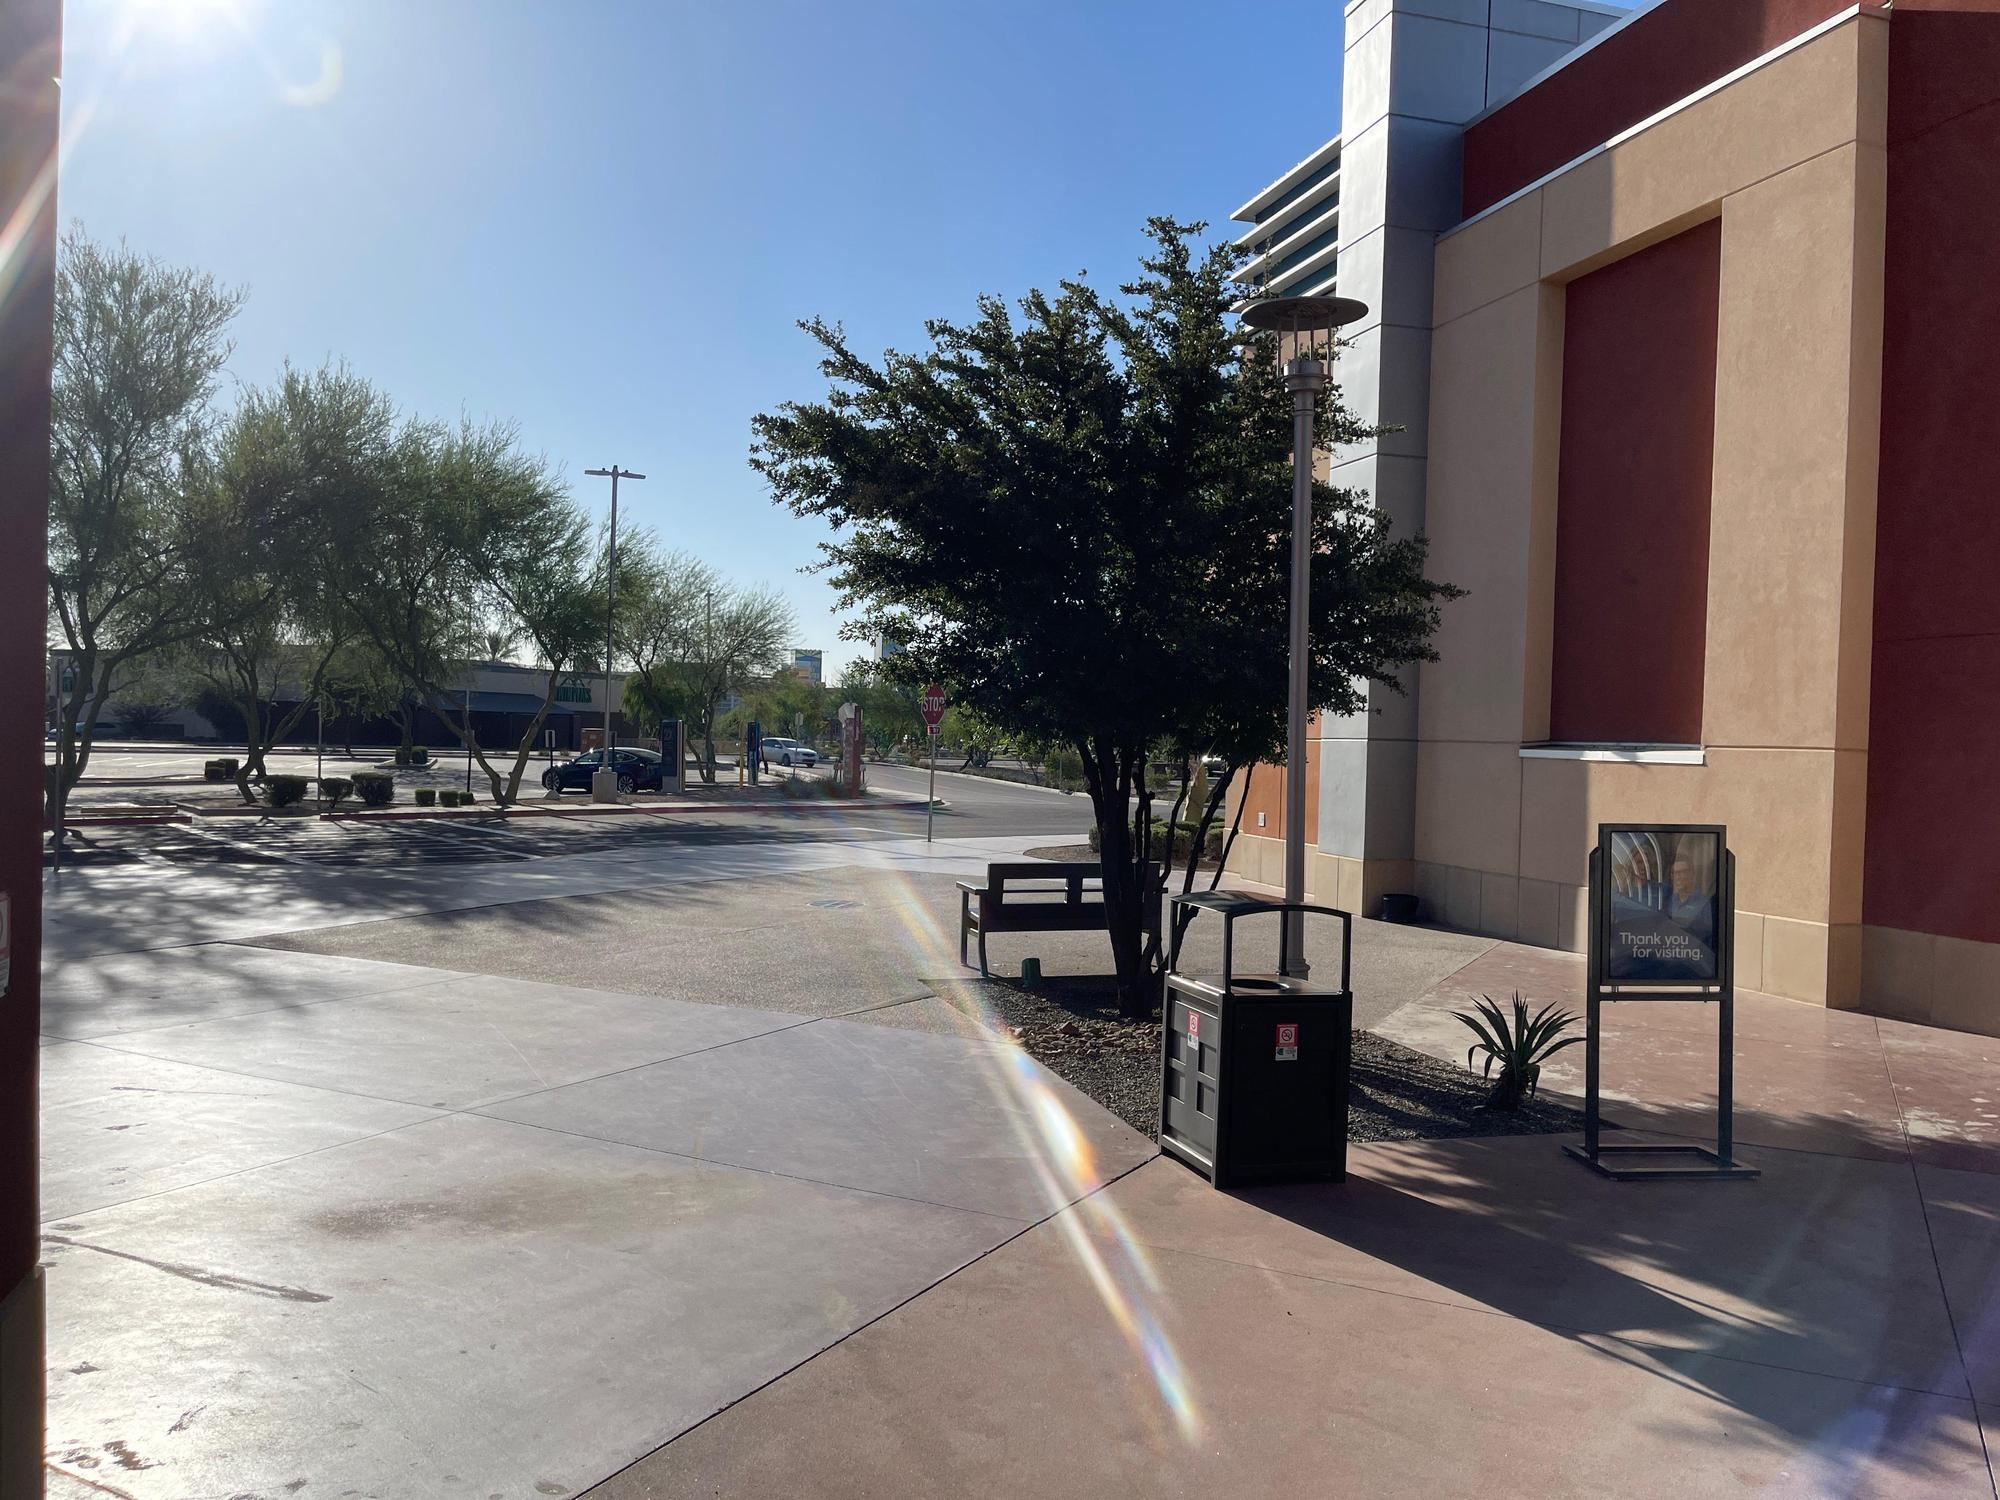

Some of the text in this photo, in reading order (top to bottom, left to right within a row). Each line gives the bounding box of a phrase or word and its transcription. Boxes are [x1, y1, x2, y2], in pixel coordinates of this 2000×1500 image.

[923, 697, 945, 711] STOP
[1619, 932, 1689, 948] Thank you
[1632, 945, 1704, 961] for visiting.
